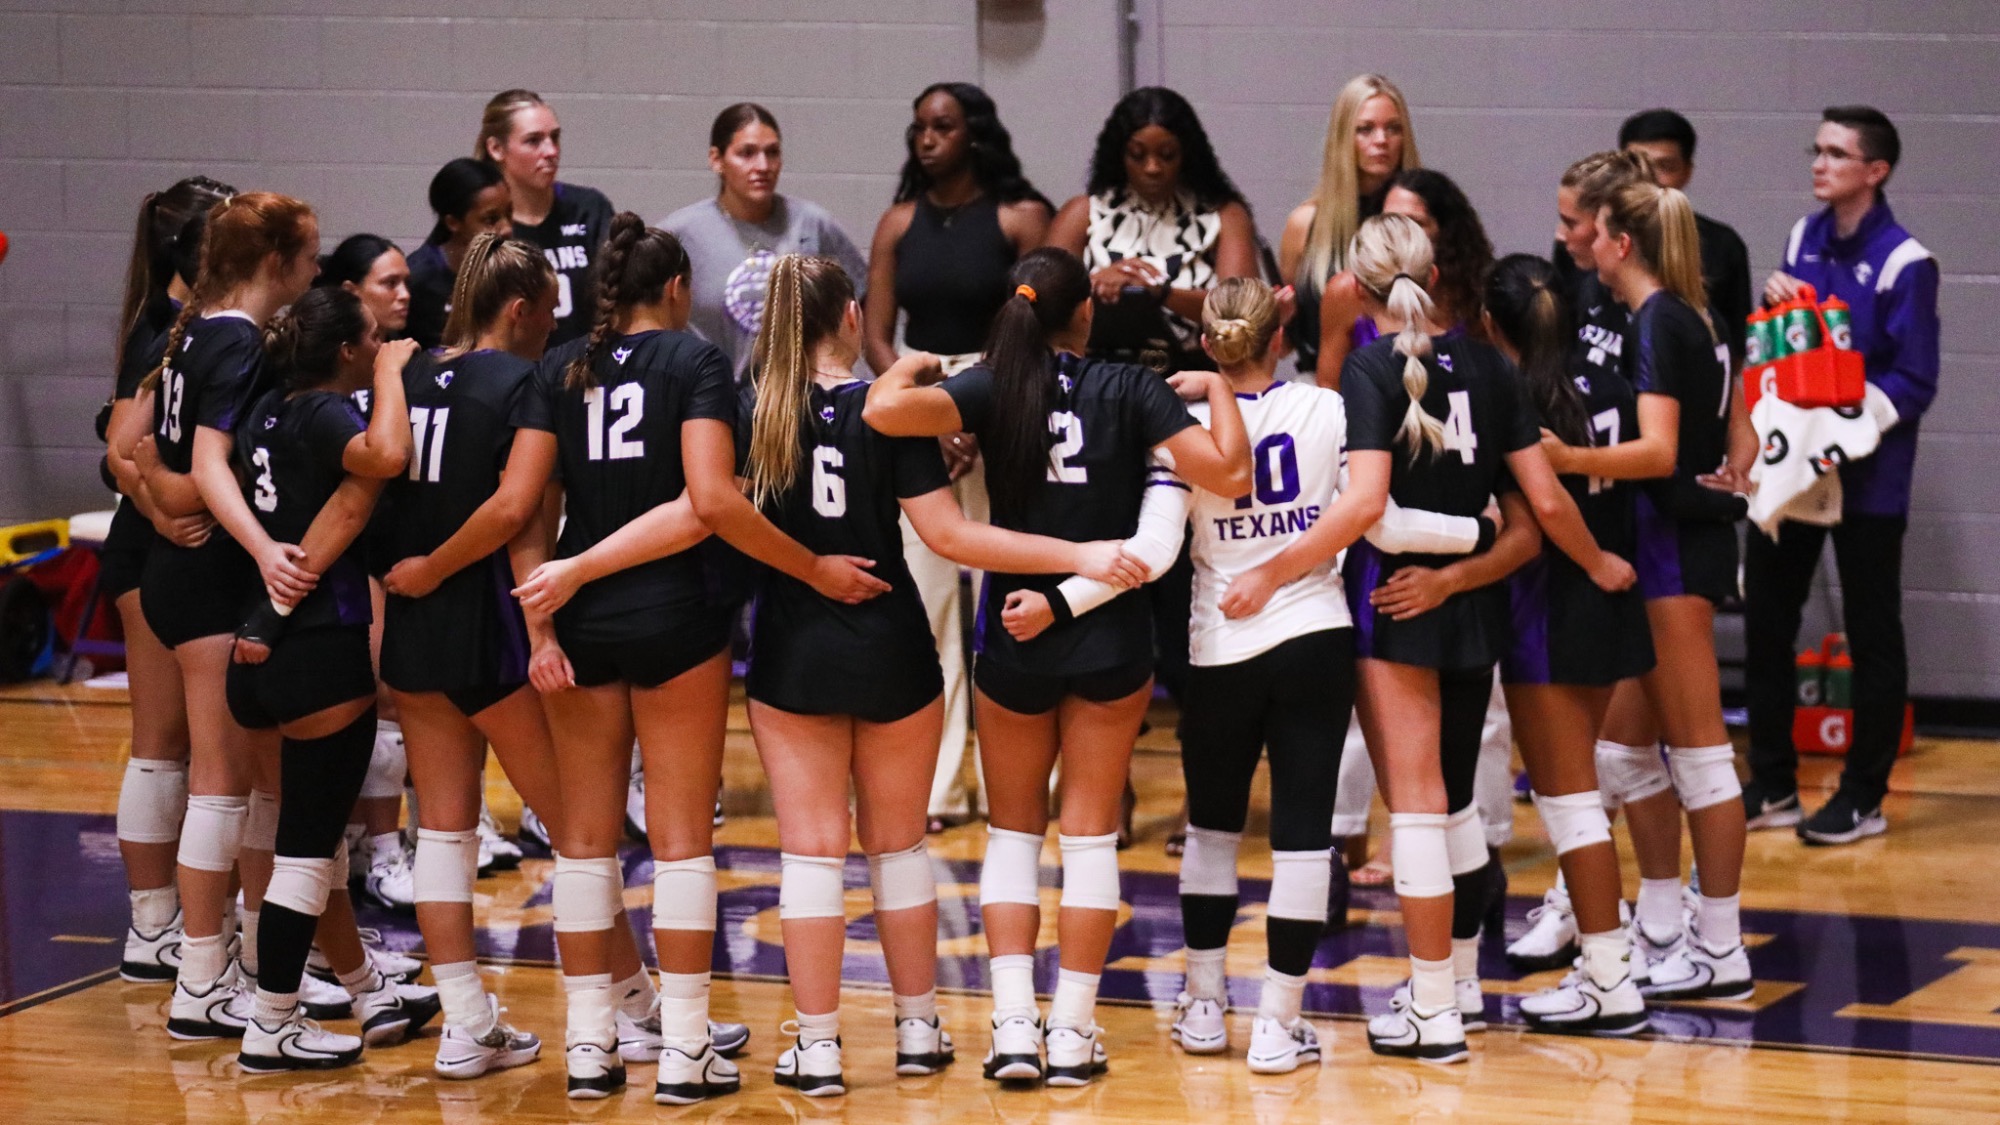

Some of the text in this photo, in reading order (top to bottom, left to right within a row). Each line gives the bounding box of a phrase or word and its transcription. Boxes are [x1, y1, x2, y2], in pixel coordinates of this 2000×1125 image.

[408, 406, 450, 483] 11
[583, 381, 645, 461] 12
[1046, 410, 1089, 484] 2
[1442, 390, 1478, 465] 4
[252, 447, 279, 513] 3
[812, 444, 847, 518] 6
[1213, 505, 1321, 541] TEXANS
[1820, 715, 1846, 748] G
